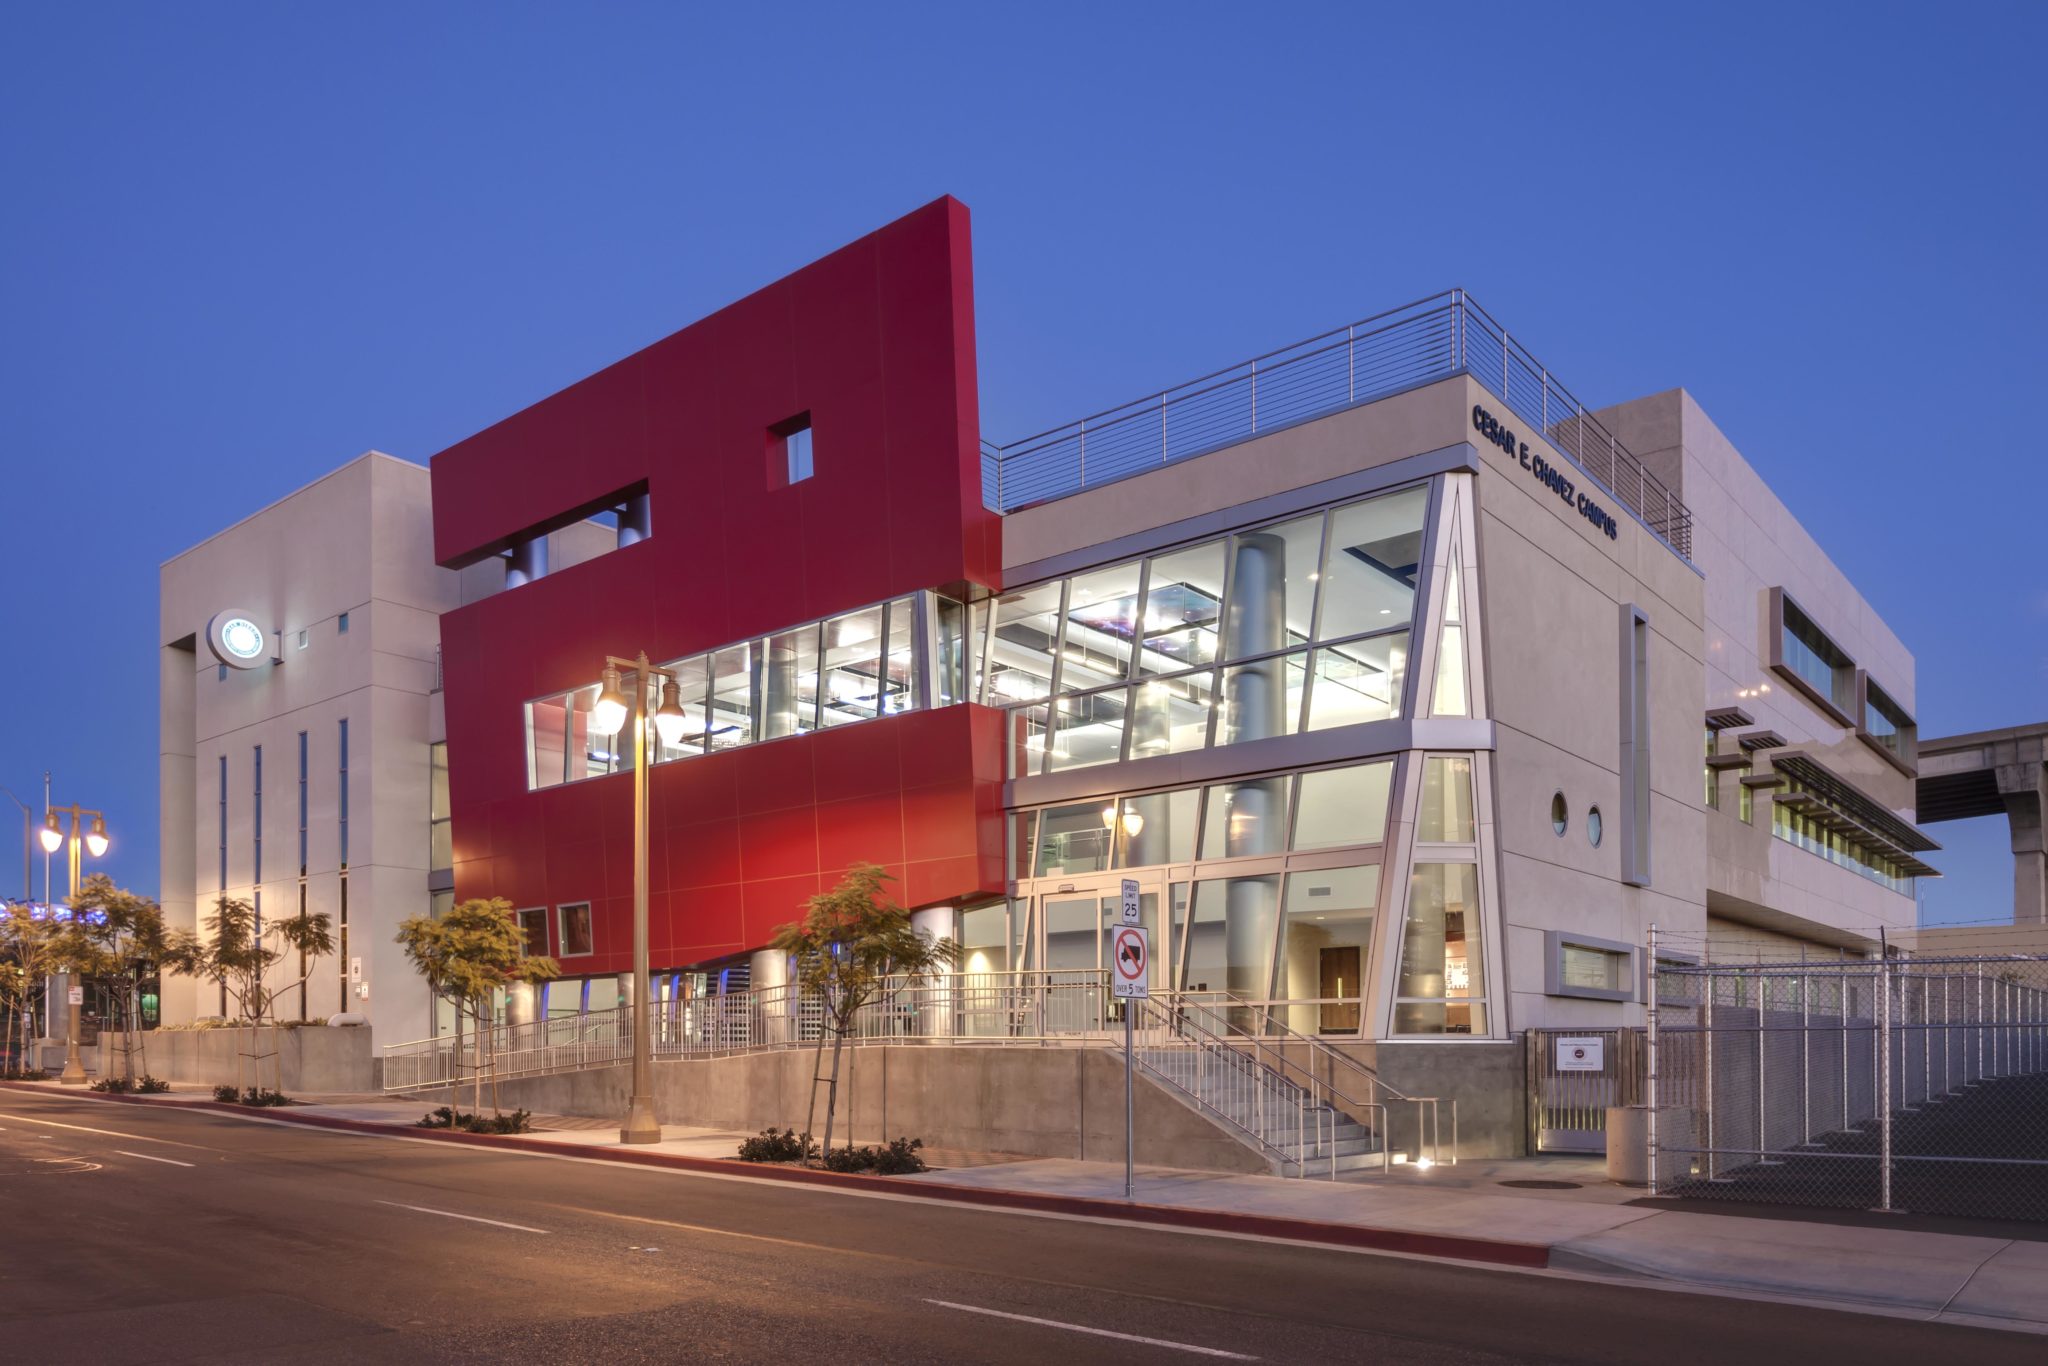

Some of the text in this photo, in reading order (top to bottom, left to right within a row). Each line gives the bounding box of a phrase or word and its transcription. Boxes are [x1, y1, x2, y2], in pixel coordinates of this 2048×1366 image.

[1472, 404, 1516, 459] CESAR
[1532, 454, 1576, 508] CHAVEZ
[1577, 492, 1618, 541] CAMPUS
[1124, 884, 1137, 892] SPEED
[1125, 902, 1137, 917] 25
[1116, 984, 1127, 993] OVER
[1128, 983, 1134, 995] 5
